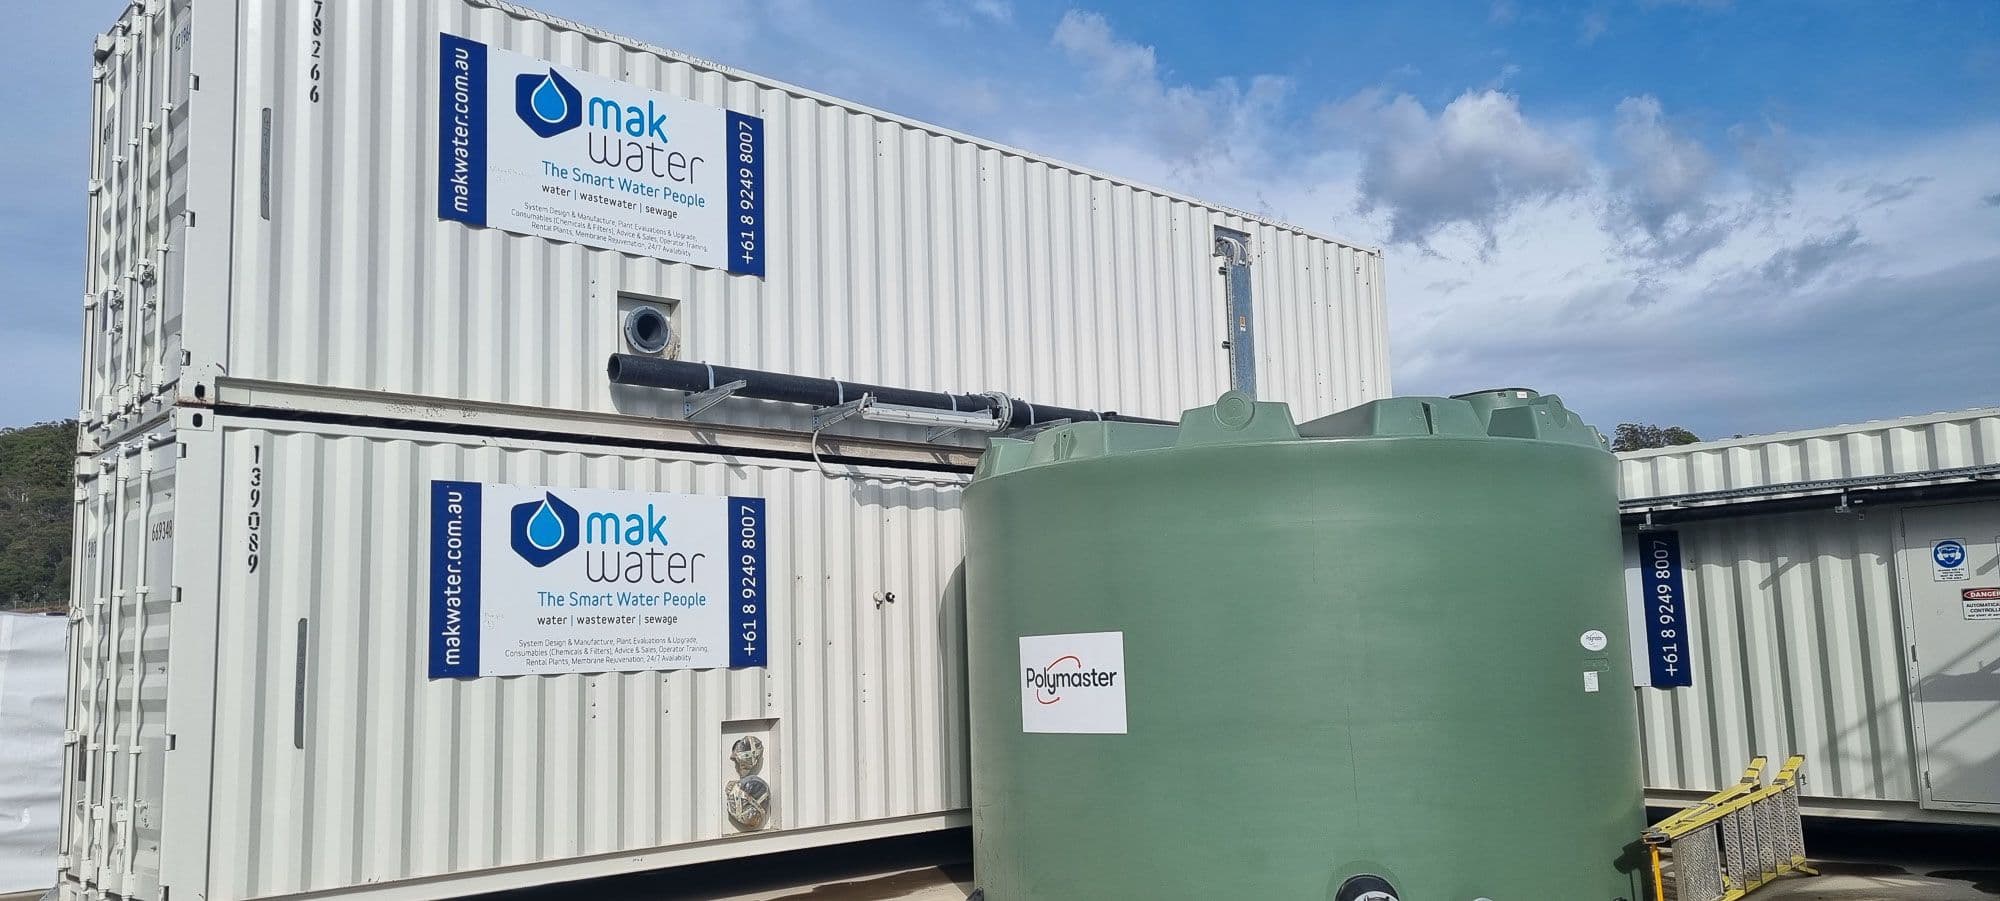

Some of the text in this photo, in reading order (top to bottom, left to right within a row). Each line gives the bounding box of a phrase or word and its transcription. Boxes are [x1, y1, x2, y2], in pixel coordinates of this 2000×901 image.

[310, 0, 323, 103] 78266
[450, 48, 469, 213] makwater.com.au
[589, 97, 668, 143] mak
[589, 132, 704, 184] water
[541, 184, 571, 197] water
[579, 191, 637, 210] wastewater
[645, 205, 678, 219] sewage
[542, 161, 705, 208] The Smart Water People
[739, 121, 754, 264] +61 8 9249 8007
[511, 208, 552, 223] Consumables
[524, 202, 548, 213] System
[550, 207, 570, 217] Design
[248, 445, 261, 574] 139089
[587, 503, 668, 546] mak
[441, 491, 463, 665] makwater.com.au
[586, 547, 706, 583] water
[741, 505, 756, 656] +61 8 9249 8007
[537, 591, 706, 608] The Smart Water People
[537, 615, 567, 625] water
[576, 615, 636, 625] wastewater
[644, 615, 678, 625] sewage
[1653, 540, 1678, 676] +61 8 9249 8007
[505, 648, 548, 657] Consumables
[614, 646, 634, 654] Advice
[518, 639, 544, 648] System
[545, 639, 566, 647] Design
[1026, 666, 1117, 695] Polymaster
